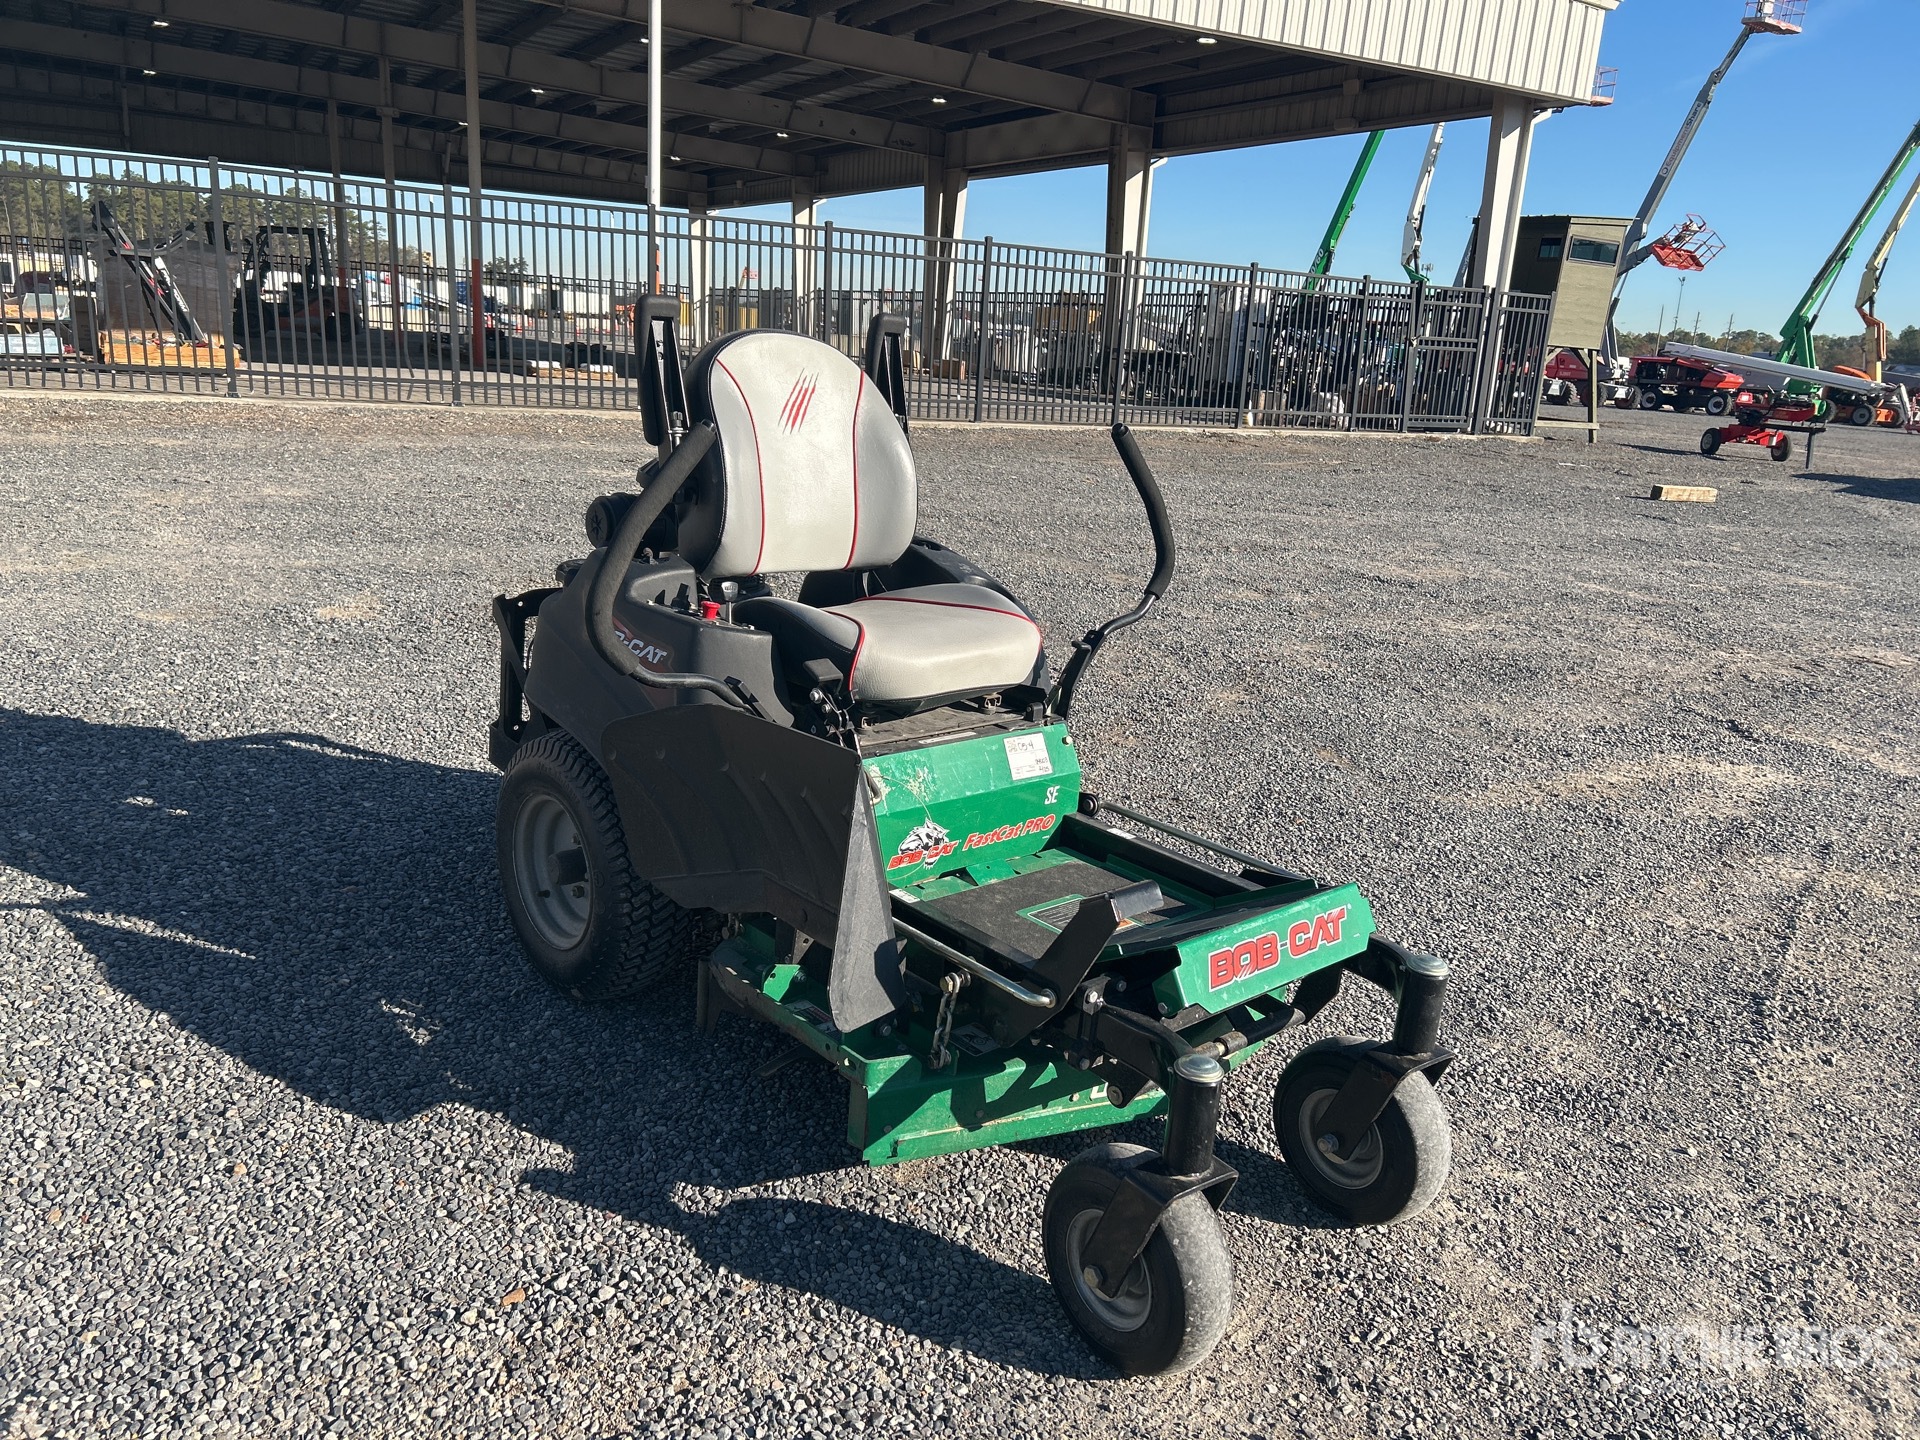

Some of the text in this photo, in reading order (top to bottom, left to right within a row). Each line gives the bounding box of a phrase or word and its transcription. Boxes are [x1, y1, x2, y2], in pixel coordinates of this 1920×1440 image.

[1667, 102, 1702, 167] EquipmentShare
[1044, 785, 1060, 805] SE
[887, 813, 1056, 871] BOB-CAT FastCat PRO
[1208, 905, 1348, 993] BOB-CAT
